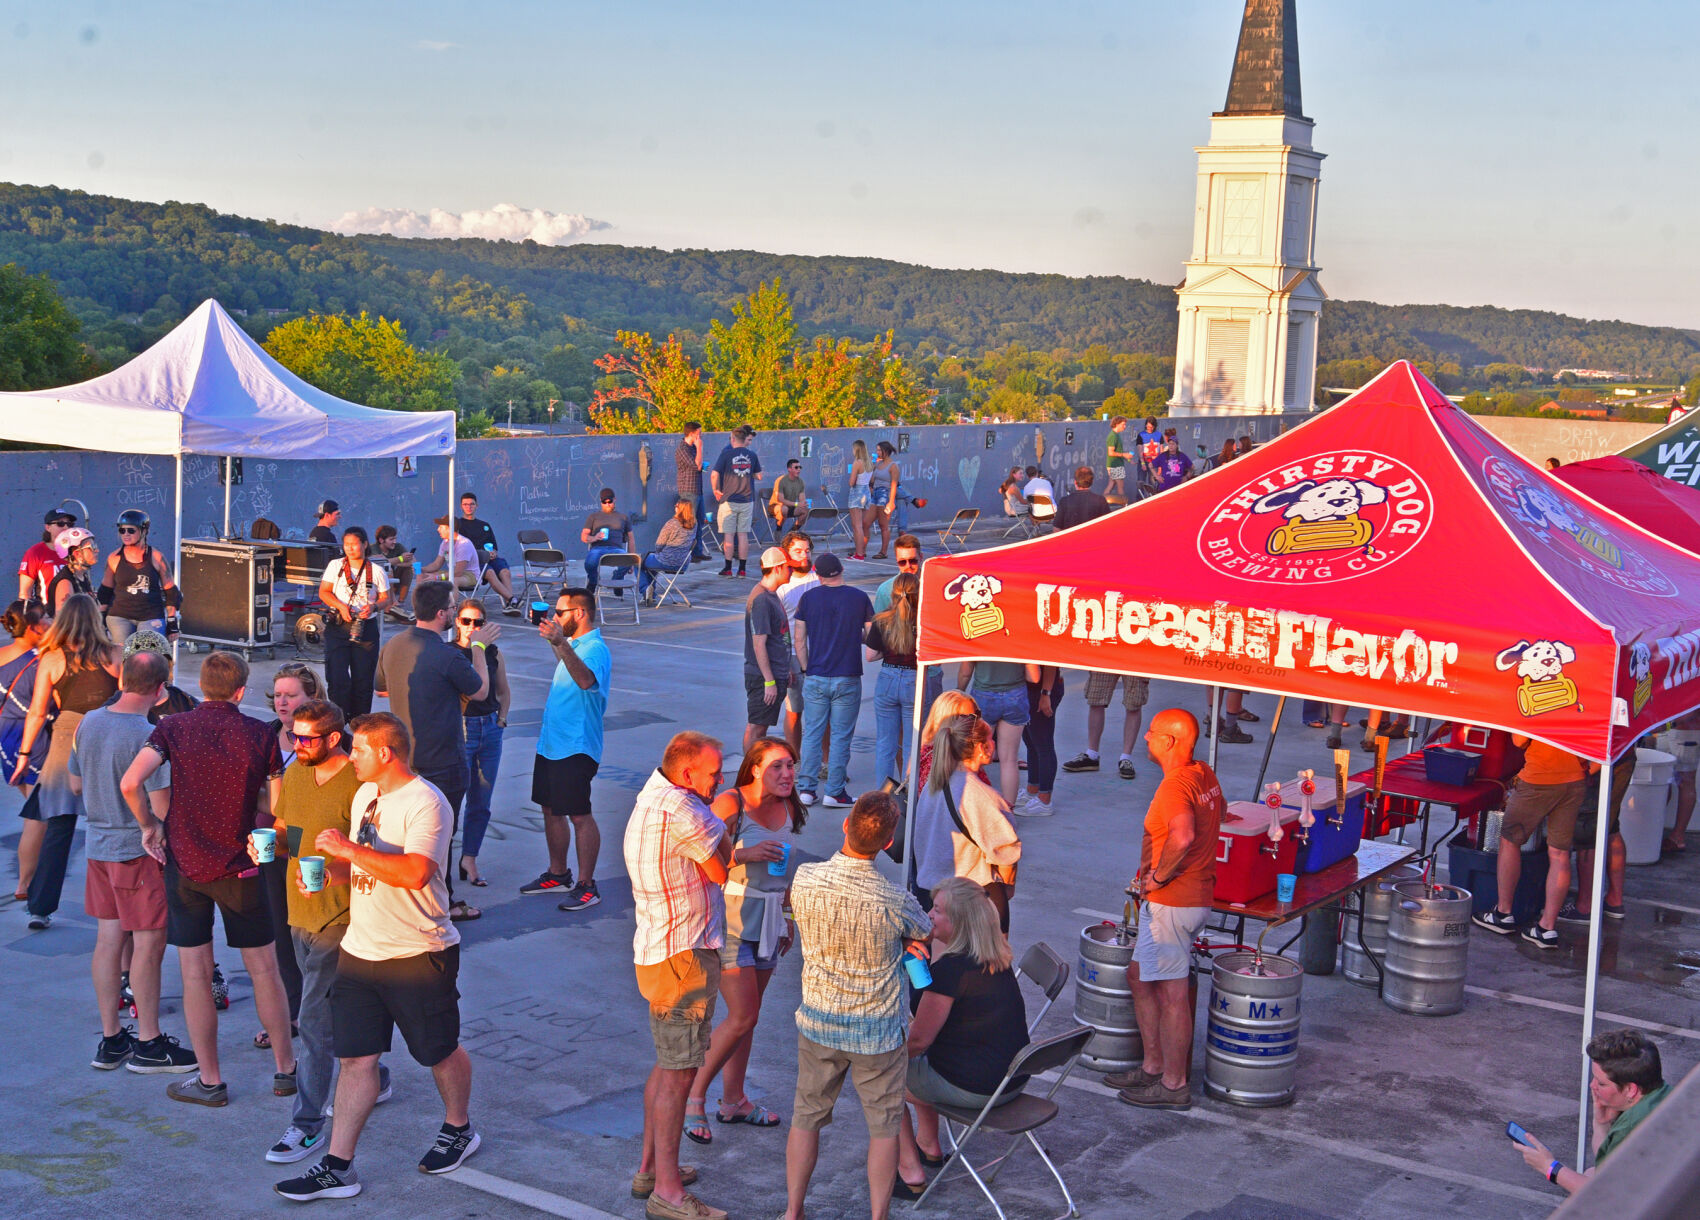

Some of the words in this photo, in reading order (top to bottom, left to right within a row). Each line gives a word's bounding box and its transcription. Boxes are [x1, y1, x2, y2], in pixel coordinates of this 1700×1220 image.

[124, 471, 153, 486] The
[116, 487, 168, 508] QUEEN
[1213, 455, 1394, 524] THIRSTY
[1387, 478, 1424, 535] DOG
[1208, 536, 1333, 580] BREWING
[1347, 549, 1395, 571] CO.
[1249, 552, 1278, 565] EST.
[1284, 557, 1325, 566] 1997
[1035, 583, 1244, 656] Unleash
[1274, 608, 1459, 686] Flavor
[1183, 655, 1287, 678] thirstydog.com
[1249, 1002, 1266, 1019] M
